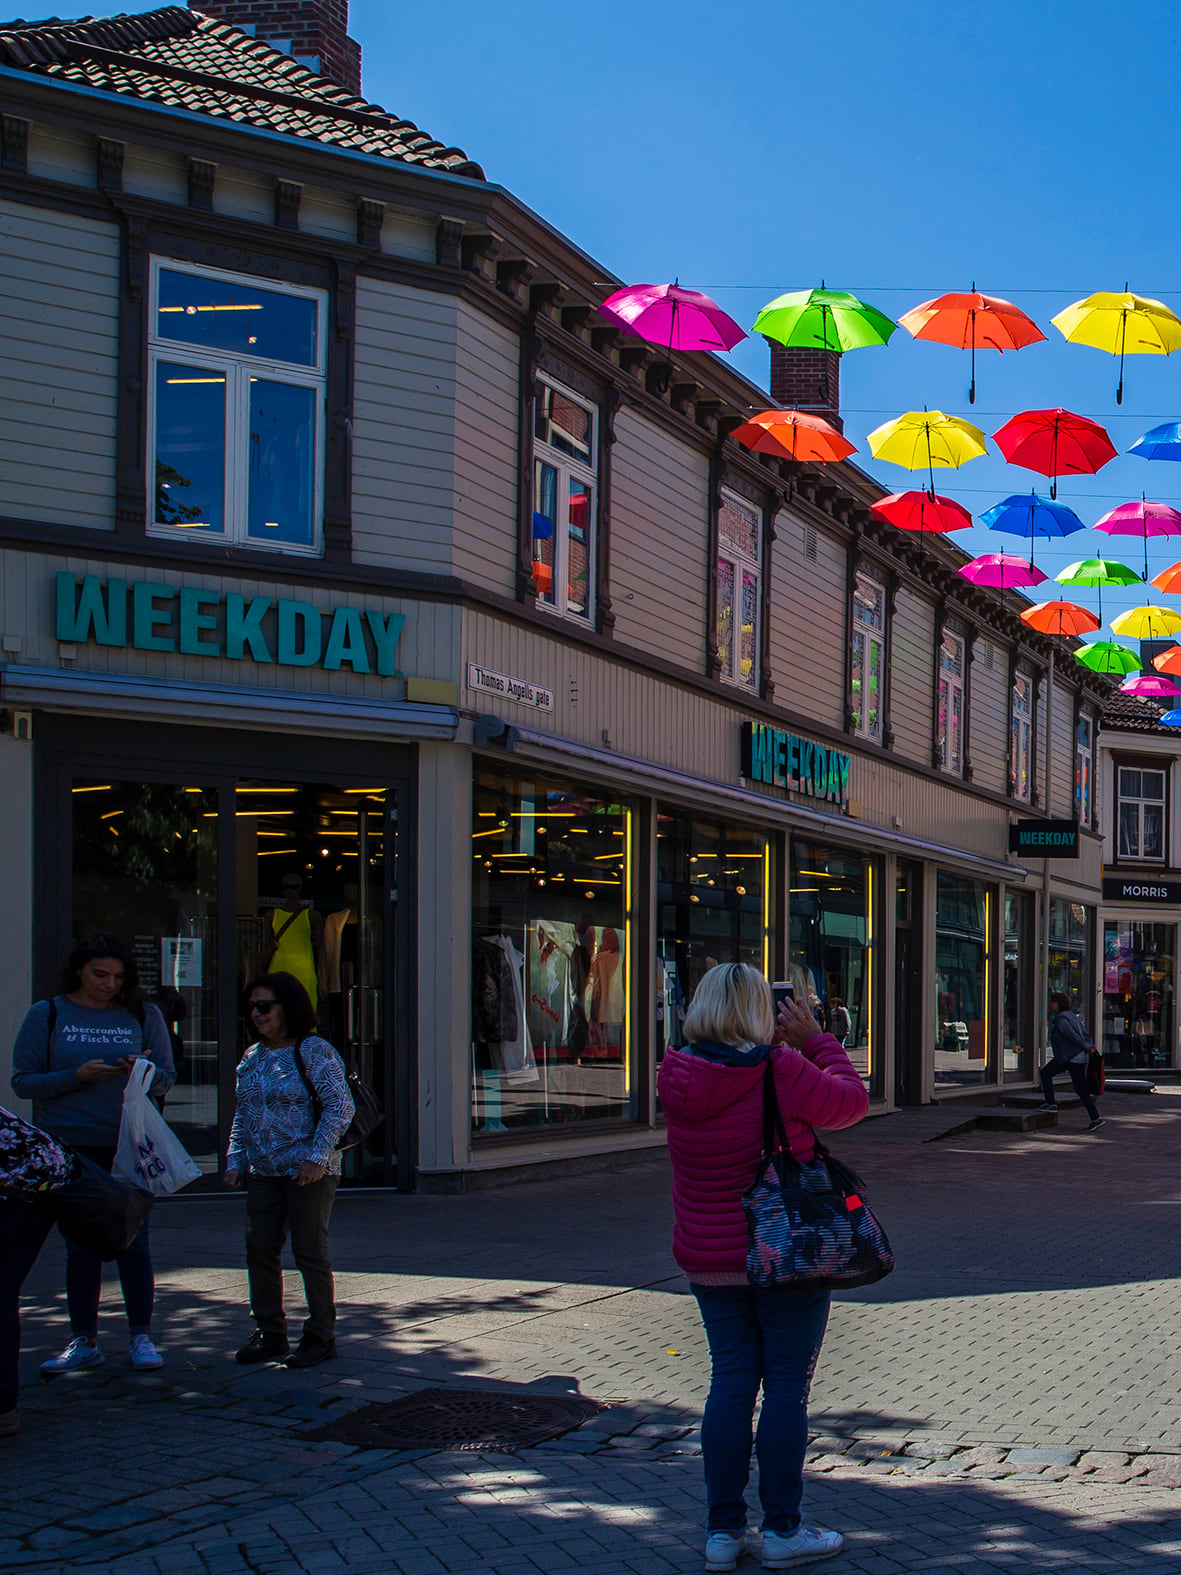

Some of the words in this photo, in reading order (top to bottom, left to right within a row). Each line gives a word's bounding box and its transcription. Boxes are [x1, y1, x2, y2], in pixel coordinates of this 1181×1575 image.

[56, 571, 406, 677] WEEKDAY
[475, 668, 505, 692] Thomas
[507, 679, 533, 701] Angells
[535, 691, 549, 706] gate
[752, 720, 850, 806] WEEKDAY
[1019, 831, 1076, 846] WEEKDAY
[1122, 885, 1168, 901] MORRIS
[62, 1024, 134, 1036] Abercrombie
[80, 1034, 110, 1044] Fitch
[112, 1035, 134, 1045] Co.
